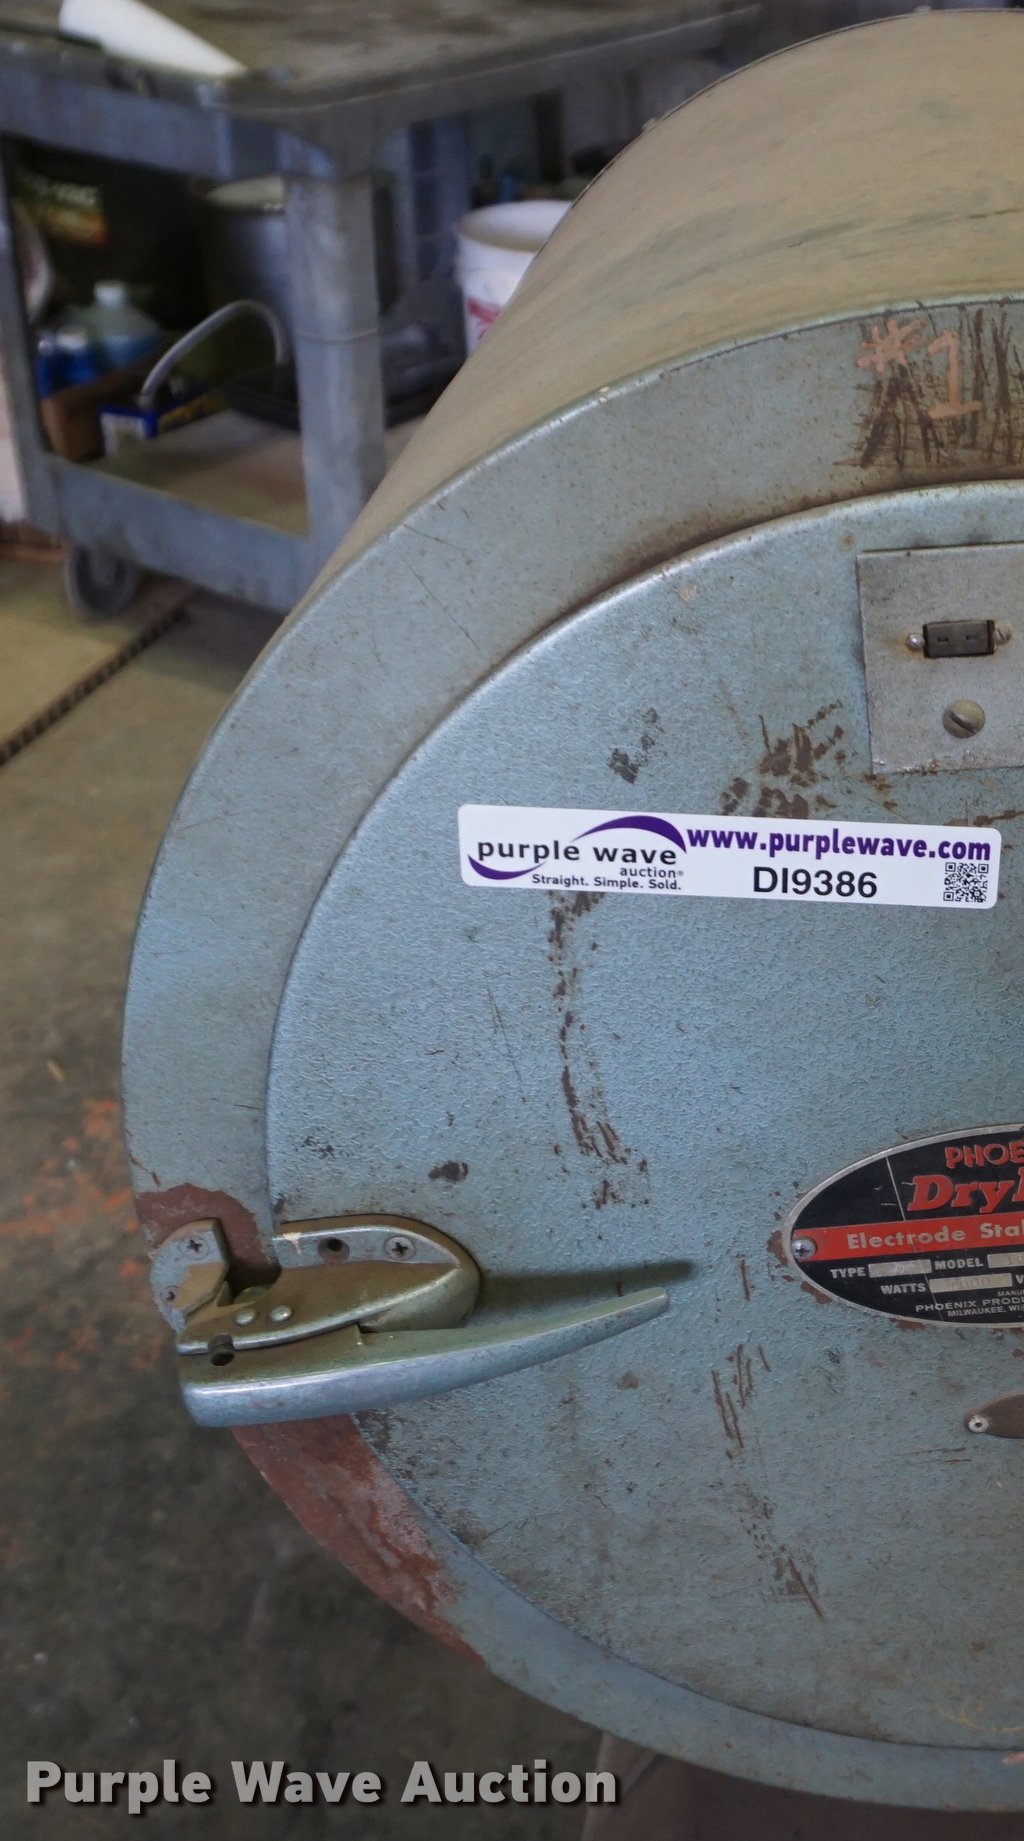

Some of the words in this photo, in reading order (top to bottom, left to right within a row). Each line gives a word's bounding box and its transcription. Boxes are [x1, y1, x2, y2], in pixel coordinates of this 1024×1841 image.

[477, 840, 580, 864] purple
[592, 845, 677, 866] wave
[686, 828, 991, 861] www.purplewave.com
[531, 873, 589, 888] Straight.
[593, 876, 644, 892] Simple.
[648, 878, 682, 890] Sold.
[752, 865, 878, 898] DI9386
[846, 1225, 967, 1250] Electrode
[830, 1266, 867, 1280] TYPE
[934, 1257, 984, 1271] MODEL
[880, 1282, 927, 1295] WATTS
[915, 1300, 977, 1313] PHOENIX
